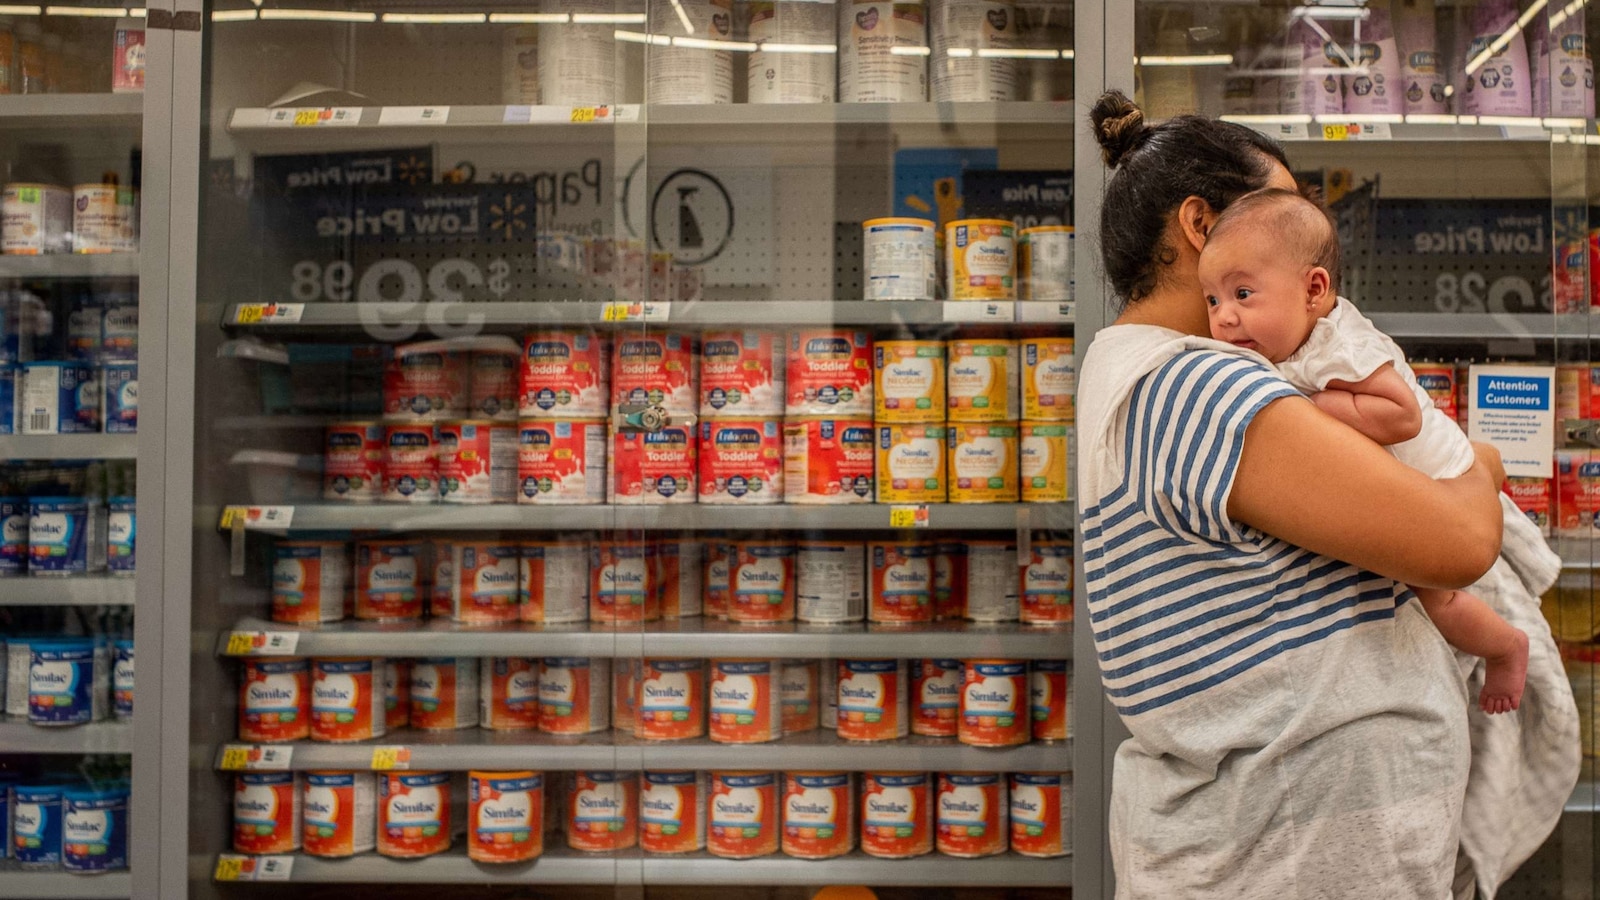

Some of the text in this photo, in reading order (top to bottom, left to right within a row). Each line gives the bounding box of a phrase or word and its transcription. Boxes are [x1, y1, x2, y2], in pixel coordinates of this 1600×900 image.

[979, 246, 1006, 254] Similac
[530, 364, 568, 373] Toddler
[621, 364, 660, 373] Toddler
[808, 362, 850, 371] Toddler
[892, 368, 922, 376] Similac
[953, 367, 978, 376] Similac
[1488, 380, 1538, 391] Attention
[1485, 393, 1541, 405] Customers
[646, 451, 686, 461] Toddler
[717, 451, 759, 461] Toddler
[902, 449, 930, 457] Similac
[1510, 485, 1545, 495] Toddler
[374, 567, 413, 581] Similac
[604, 569, 642, 582] Similac
[741, 571, 780, 582] Similac
[890, 570, 927, 582] Similac
[1029, 569, 1067, 582] Similac
[31, 671, 67, 684] Similac
[251, 687, 292, 699] Similac
[314, 687, 349, 700] Similac
[645, 686, 685, 698] Similac
[713, 687, 749, 701] Similac
[841, 685, 876, 699] Similac
[969, 689, 1010, 702] Similac
[393, 801, 435, 813] Similac
[580, 795, 620, 809] Similac
[716, 801, 755, 814] Similac
[791, 801, 829, 814] Similac
[868, 800, 908, 814] Similac
[942, 799, 980, 812] Similac
[484, 805, 526, 818] Similac
[67, 820, 101, 833] Similac
